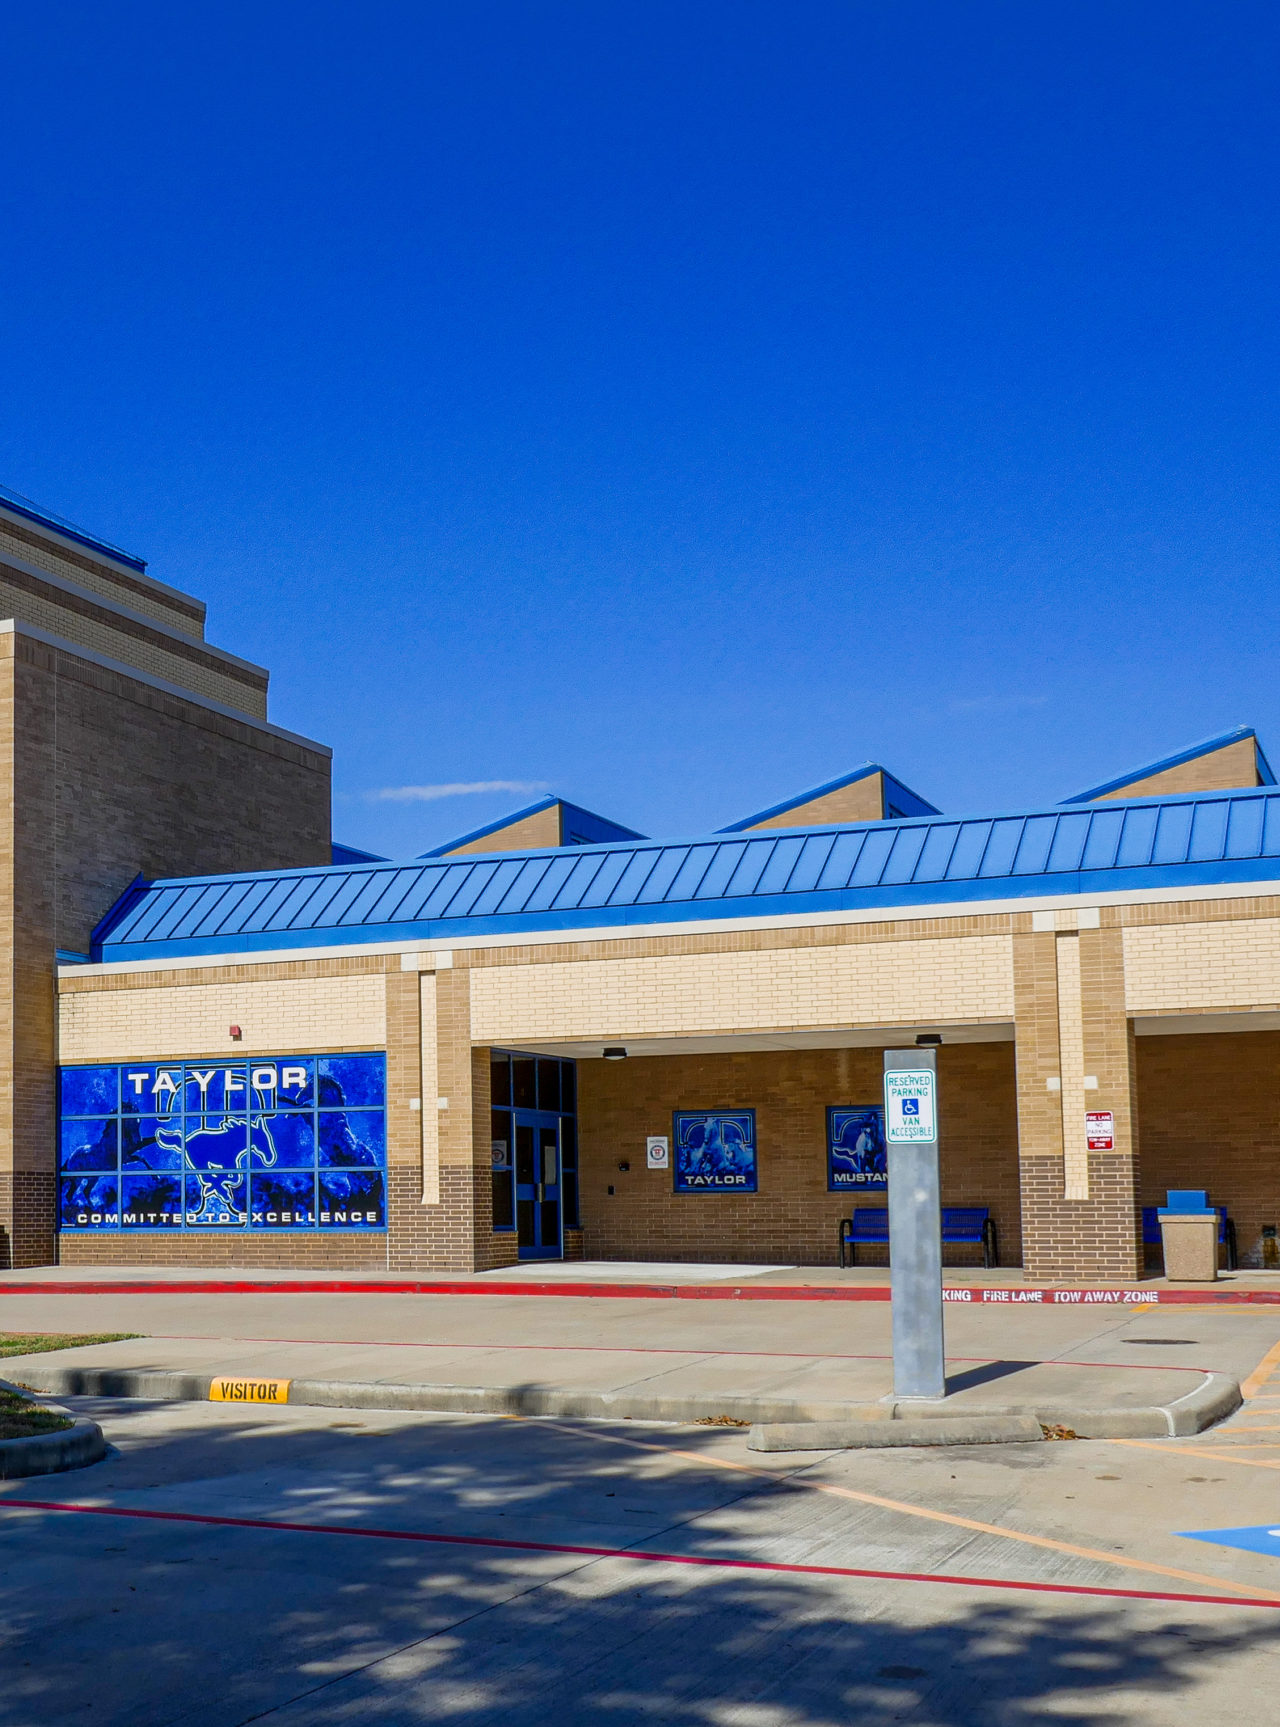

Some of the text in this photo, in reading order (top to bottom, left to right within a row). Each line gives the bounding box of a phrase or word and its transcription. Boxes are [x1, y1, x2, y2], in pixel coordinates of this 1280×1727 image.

[128, 1067, 307, 1094] TAYLOR
[888, 1076, 930, 1086] RESERVED
[891, 1087, 928, 1097] PARKING
[902, 1117, 920, 1126] VAN
[891, 1126, 932, 1136] ACCESSIBLE
[685, 1175, 746, 1185] TAYLOR
[834, 1173, 888, 1182] MUSTAN
[77, 1211, 377, 1224] COMMITTED TO EXCELLENCE
[942, 1290, 1159, 1302] KING FIRE LANE TOW AWAY ZONE
[221, 1382, 278, 1400] VISITOR
